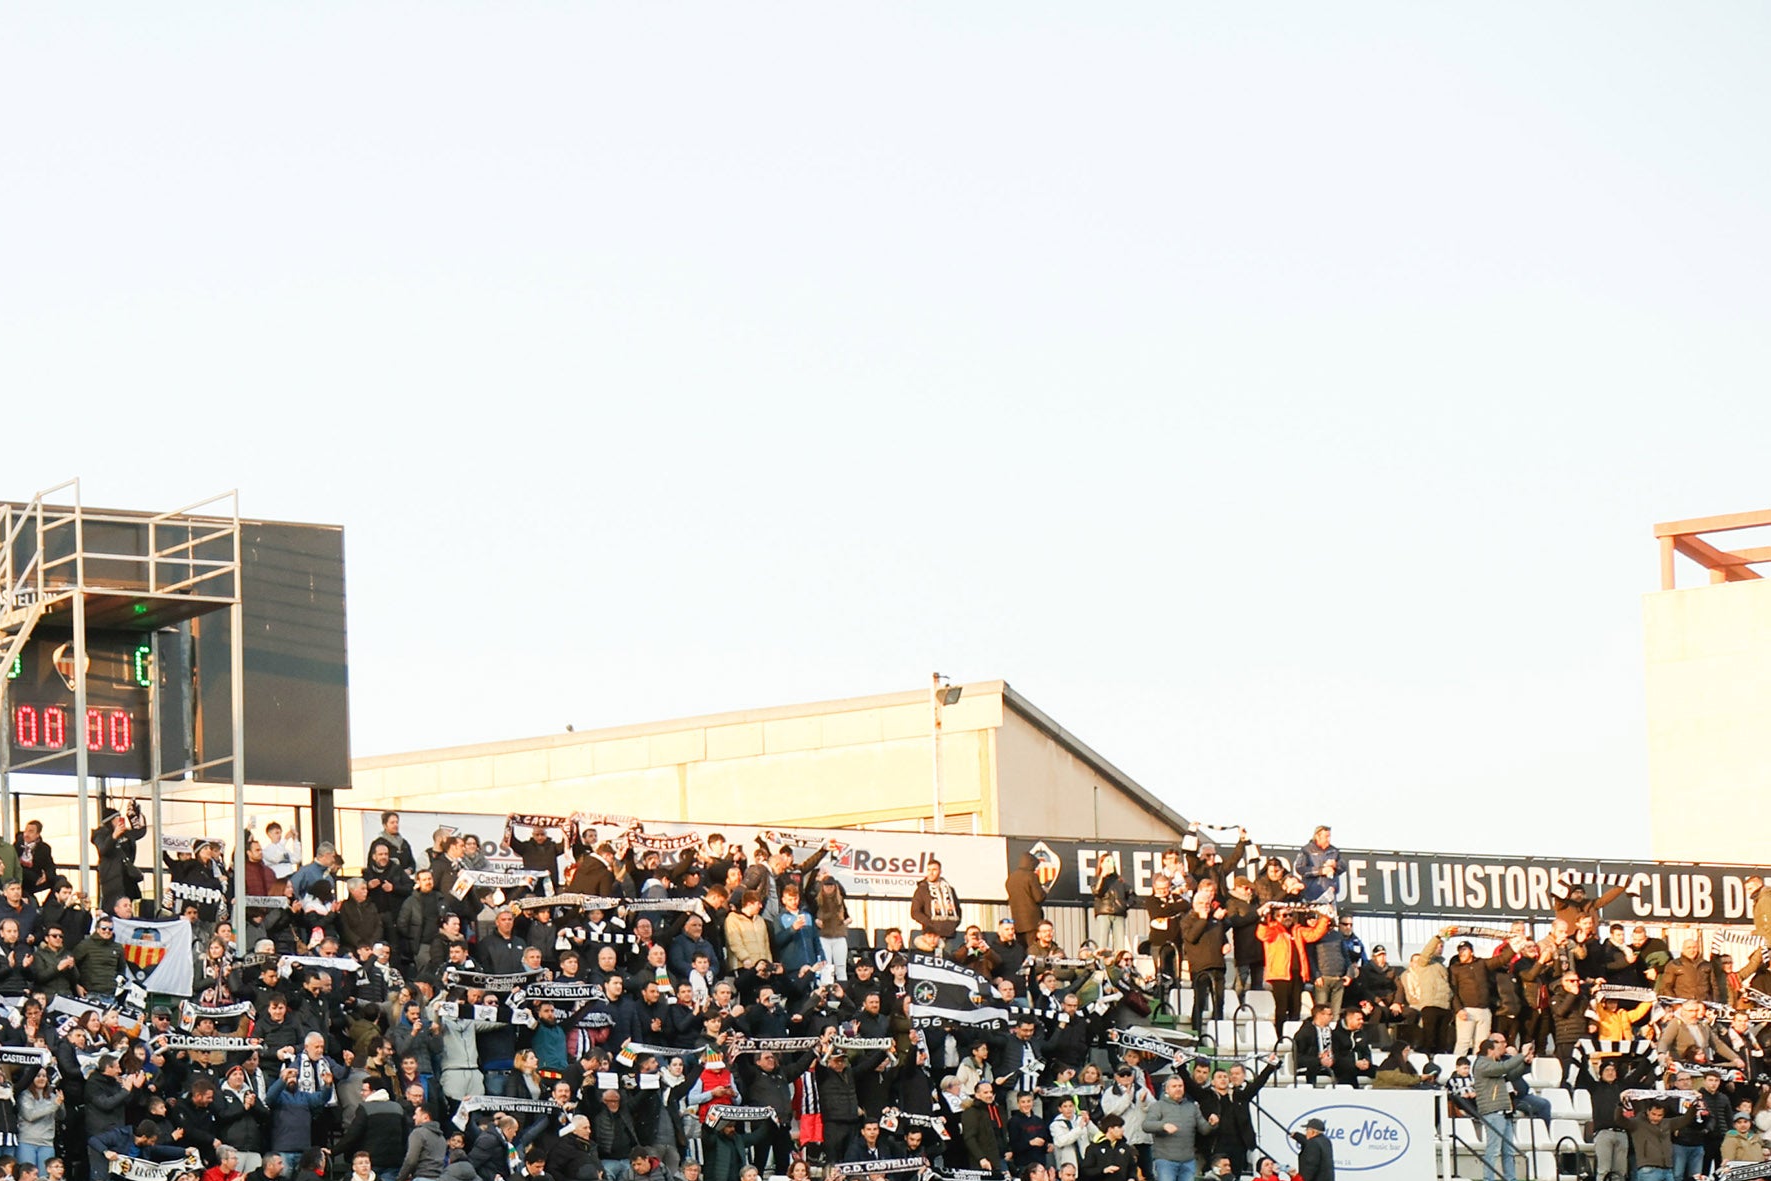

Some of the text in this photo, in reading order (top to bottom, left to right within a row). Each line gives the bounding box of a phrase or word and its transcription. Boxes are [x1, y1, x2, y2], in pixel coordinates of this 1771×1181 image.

[1377, 860, 1418, 906] TU
[1432, 861, 1560, 911] HISTORI
[1632, 871, 1713, 919] CLUB
[866, 1157, 923, 1172] CASTELLON
